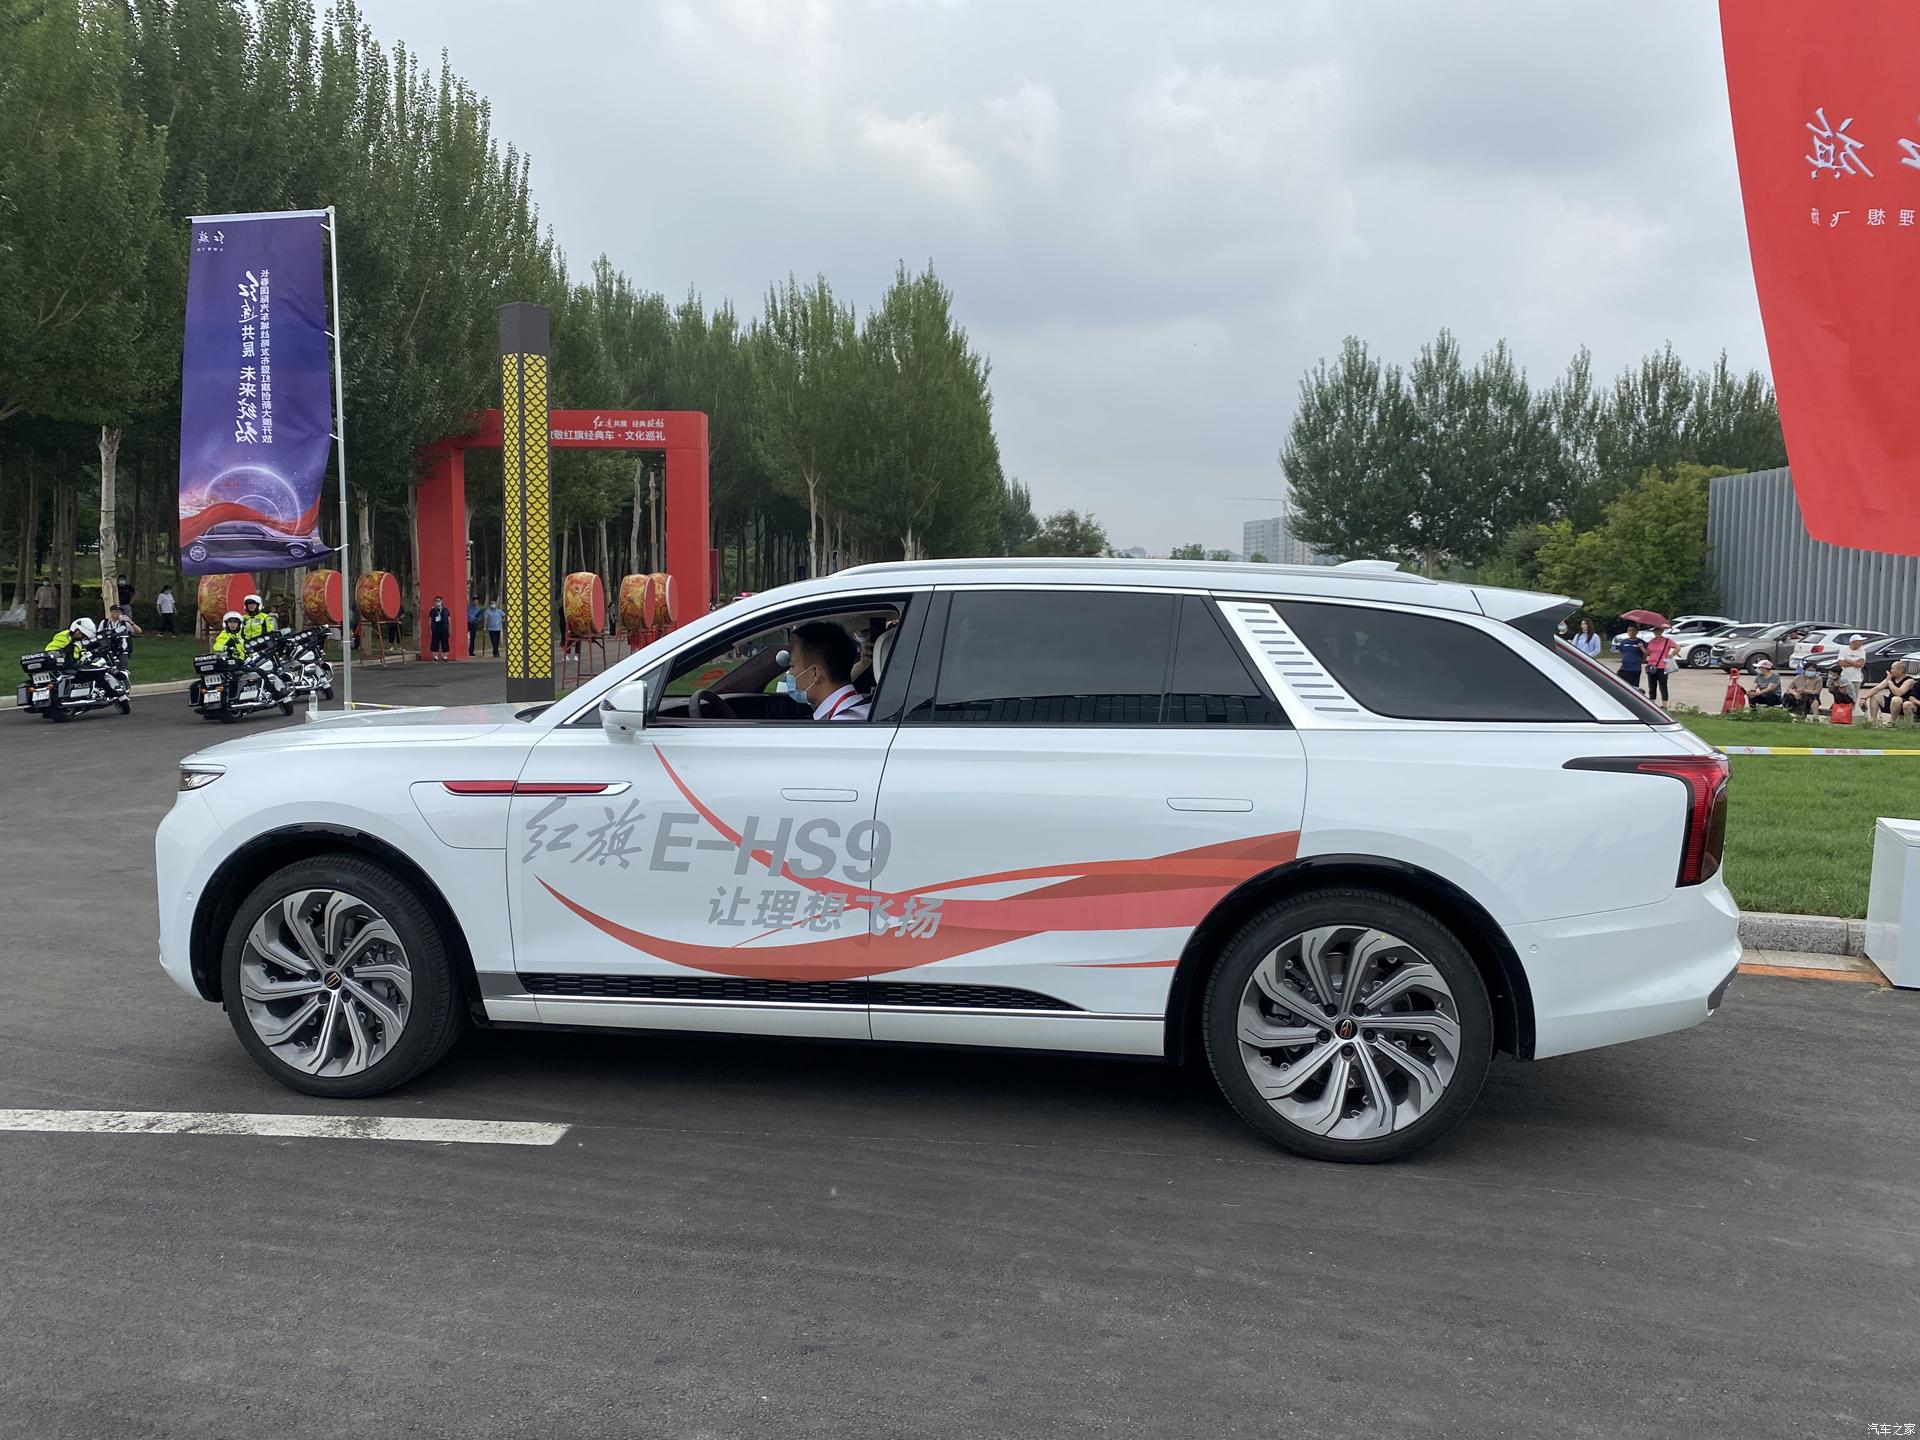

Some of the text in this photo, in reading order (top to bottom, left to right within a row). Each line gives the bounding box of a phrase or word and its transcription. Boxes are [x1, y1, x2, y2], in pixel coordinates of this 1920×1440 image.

[522, 796, 892, 882] 红旗 E-HS9
[707, 886, 944, 939] 让理想飞扬
